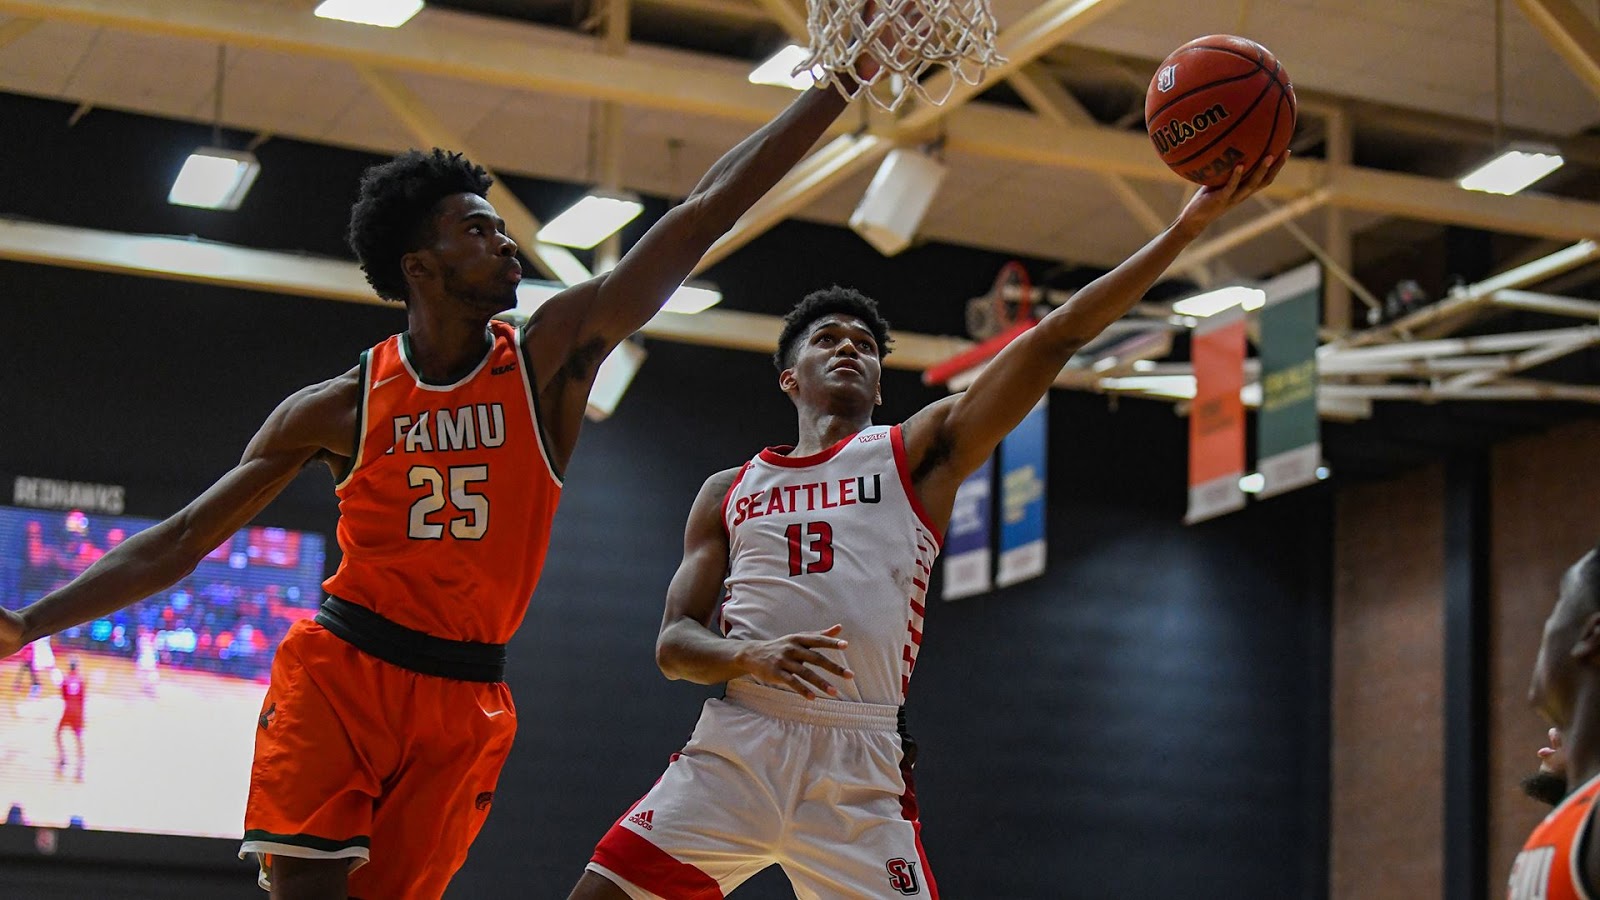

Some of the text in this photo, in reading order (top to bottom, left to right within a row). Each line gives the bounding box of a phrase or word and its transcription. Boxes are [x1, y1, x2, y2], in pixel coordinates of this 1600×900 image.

[1151, 102, 1230, 155] Wilson
[385, 402, 505, 454] FAMU
[407, 463, 490, 540] 25
[784, 520, 835, 577] 13
[628, 816, 654, 831] adidas
